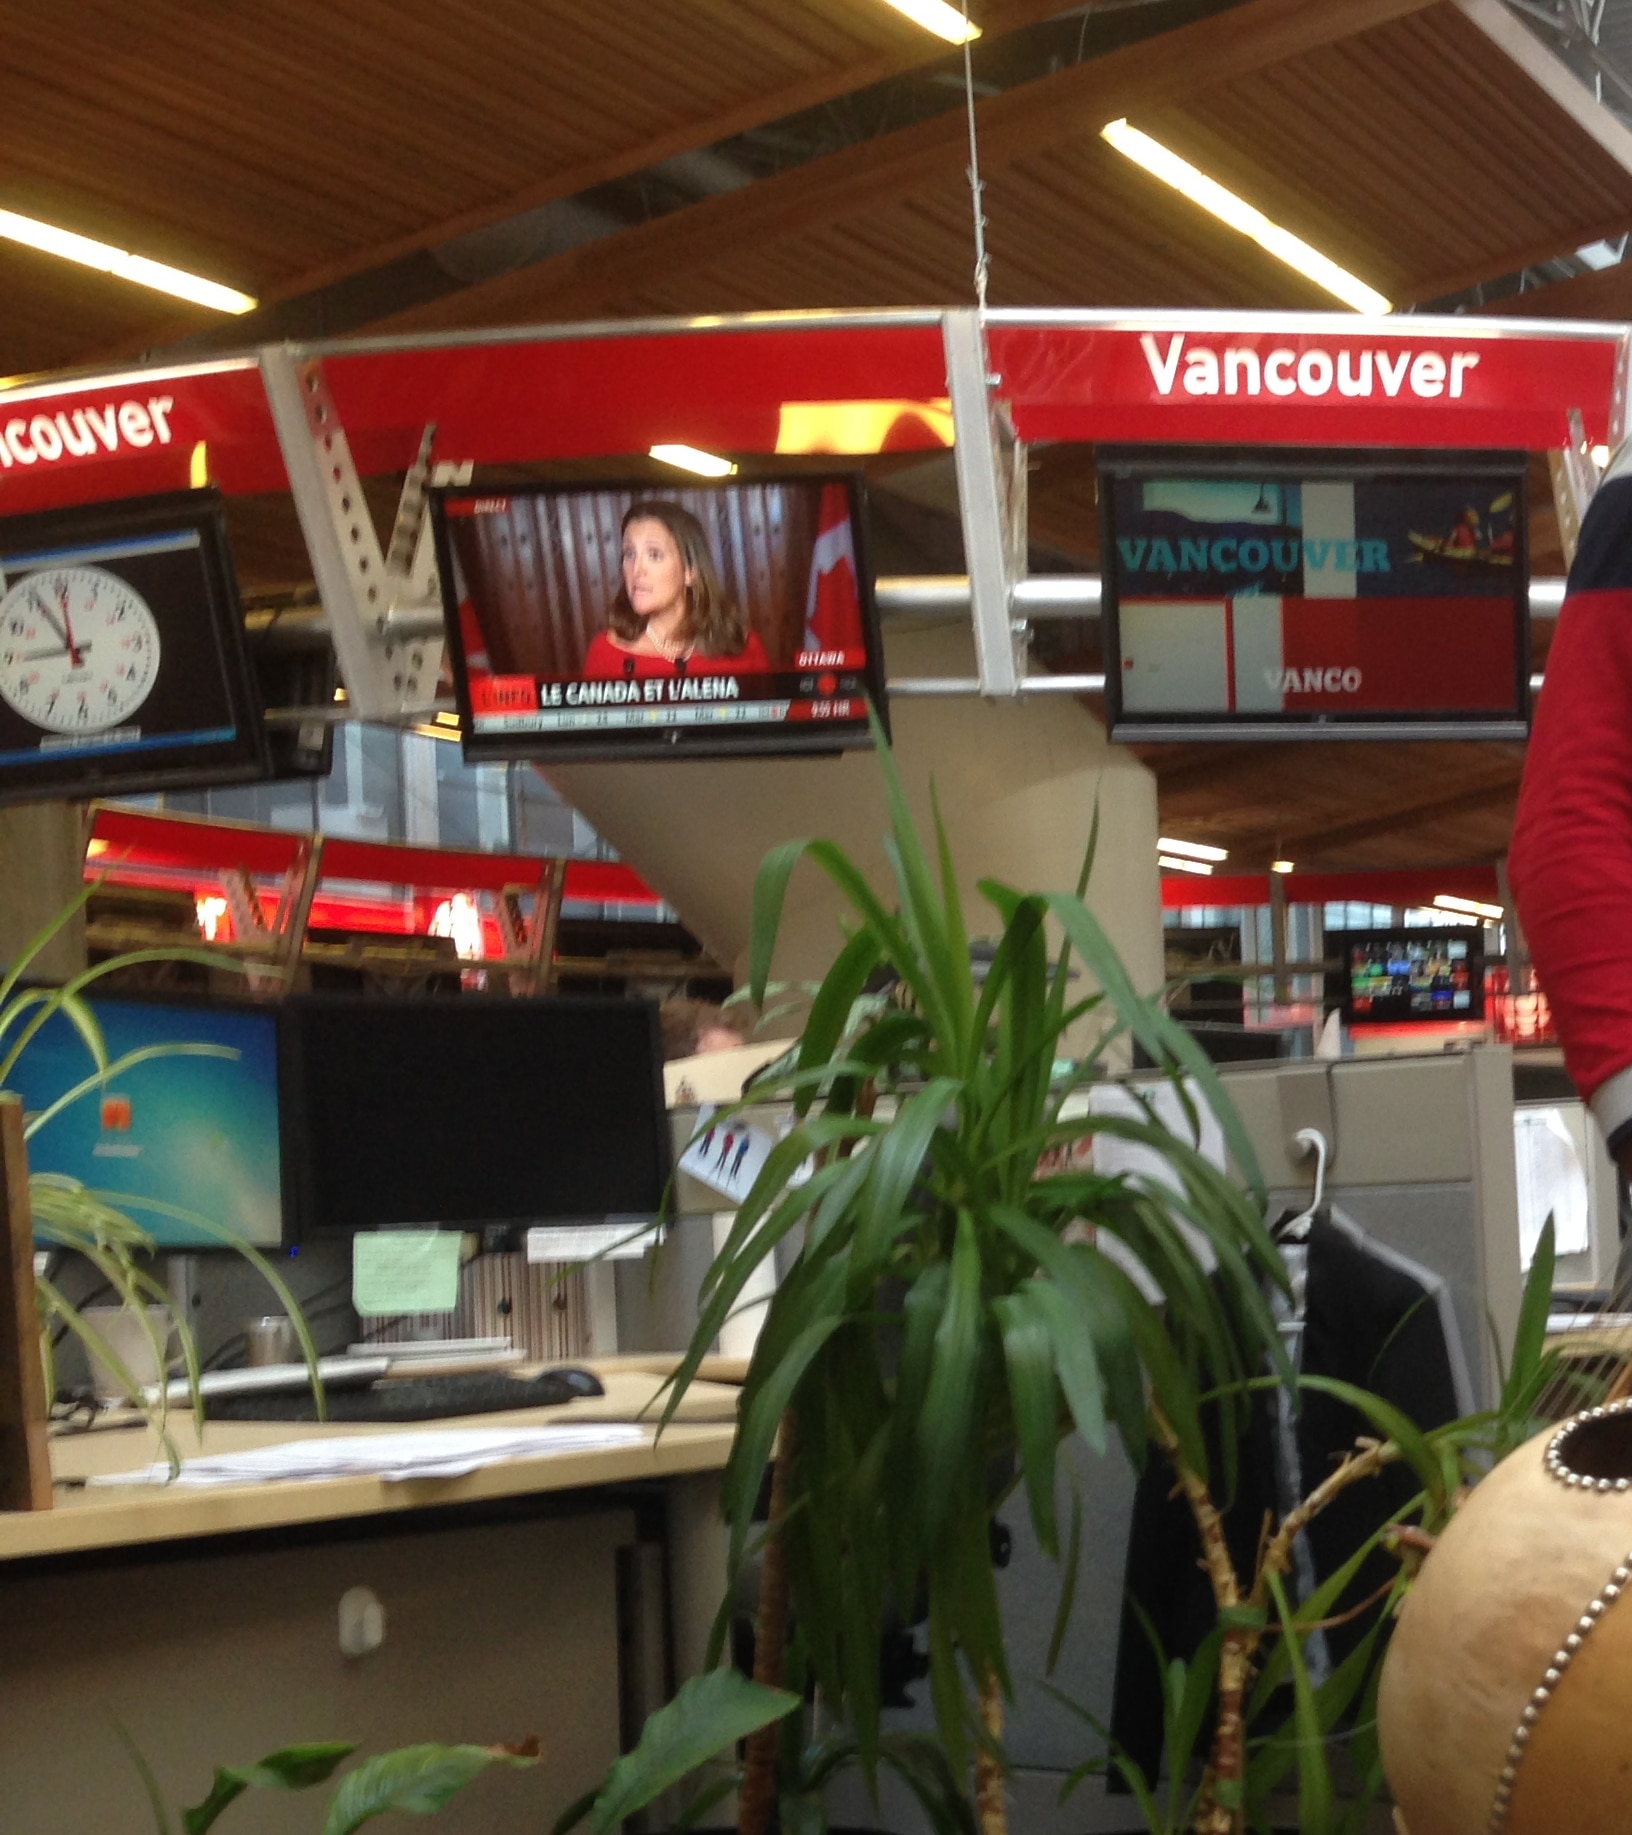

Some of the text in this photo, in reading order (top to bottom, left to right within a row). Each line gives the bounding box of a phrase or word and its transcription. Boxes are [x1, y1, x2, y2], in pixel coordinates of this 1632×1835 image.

[1139, 332, 1480, 398] Vancouver
[1117, 537, 1391, 573] VANCOUVER
[798, 650, 845, 667] OTTAWA
[541, 675, 739, 706] LE CANADA ET L'ALENA
[1265, 667, 1362, 693] VANCO
